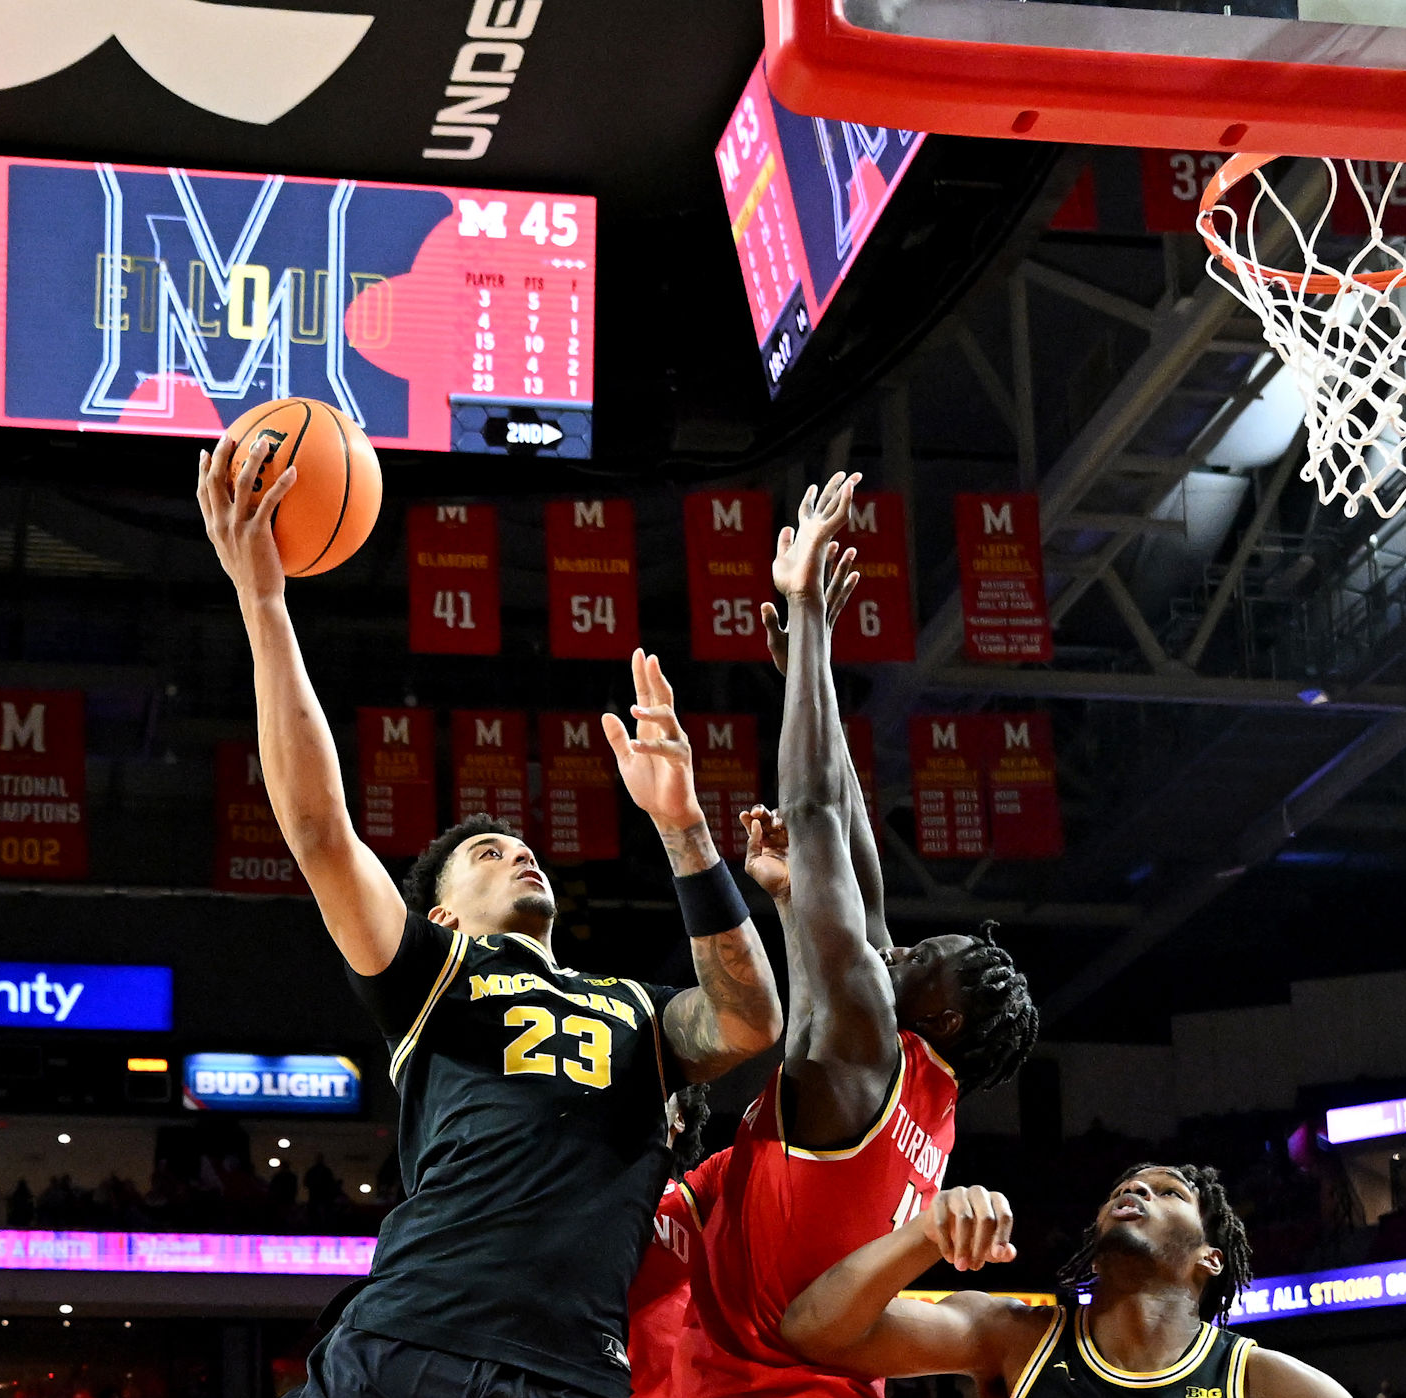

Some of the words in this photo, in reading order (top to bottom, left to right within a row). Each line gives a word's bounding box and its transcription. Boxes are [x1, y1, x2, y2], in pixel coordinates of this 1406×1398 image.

[458, 199, 507, 238] M
[520, 201, 578, 247] 45
[524, 276, 544, 291] PTS
[478, 289, 491, 308] 3
[570, 294, 579, 313] 1
[477, 312, 490, 330] 4
[527, 314, 539, 333] 7
[570, 317, 579, 335] 1
[475, 332, 495, 351] 15
[524, 335, 545, 353] 10
[567, 337, 580, 355] 2
[472, 353, 493, 371] 21
[526, 356, 539, 374] 4
[567, 358, 580, 376] 2
[472, 373, 495, 392] 23
[523, 376, 544, 395] 13
[568, 379, 578, 397] 1
[506, 421, 543, 444] 2ND
[436, 504, 469, 525] M
[573, 500, 606, 529] M
[712, 499, 744, 533] M
[848, 501, 879, 535] M
[981, 501, 1016, 536] M
[432, 590, 477, 629] 41
[570, 594, 617, 635] 54
[712, 597, 756, 637] 25
[859, 600, 882, 638] 6
[0, 701, 47, 753] M
[382, 715, 412, 746] M
[475, 719, 502, 748] M
[564, 720, 591, 750] M
[706, 721, 735, 750] M
[930, 721, 959, 751] M
[1003, 721, 1031, 750] M
[229, 857, 293, 881] 2002
[504, 1005, 613, 1090] 23
[195, 1070, 261, 1097] BUD
[262, 1071, 352, 1100] LIGHT
[27, 1240, 92, 1261] MONTH
[316, 1244, 351, 1265] ALL
[1272, 1285, 1309, 1311] ALL
[1309, 1275, 1383, 1307] STRONG
